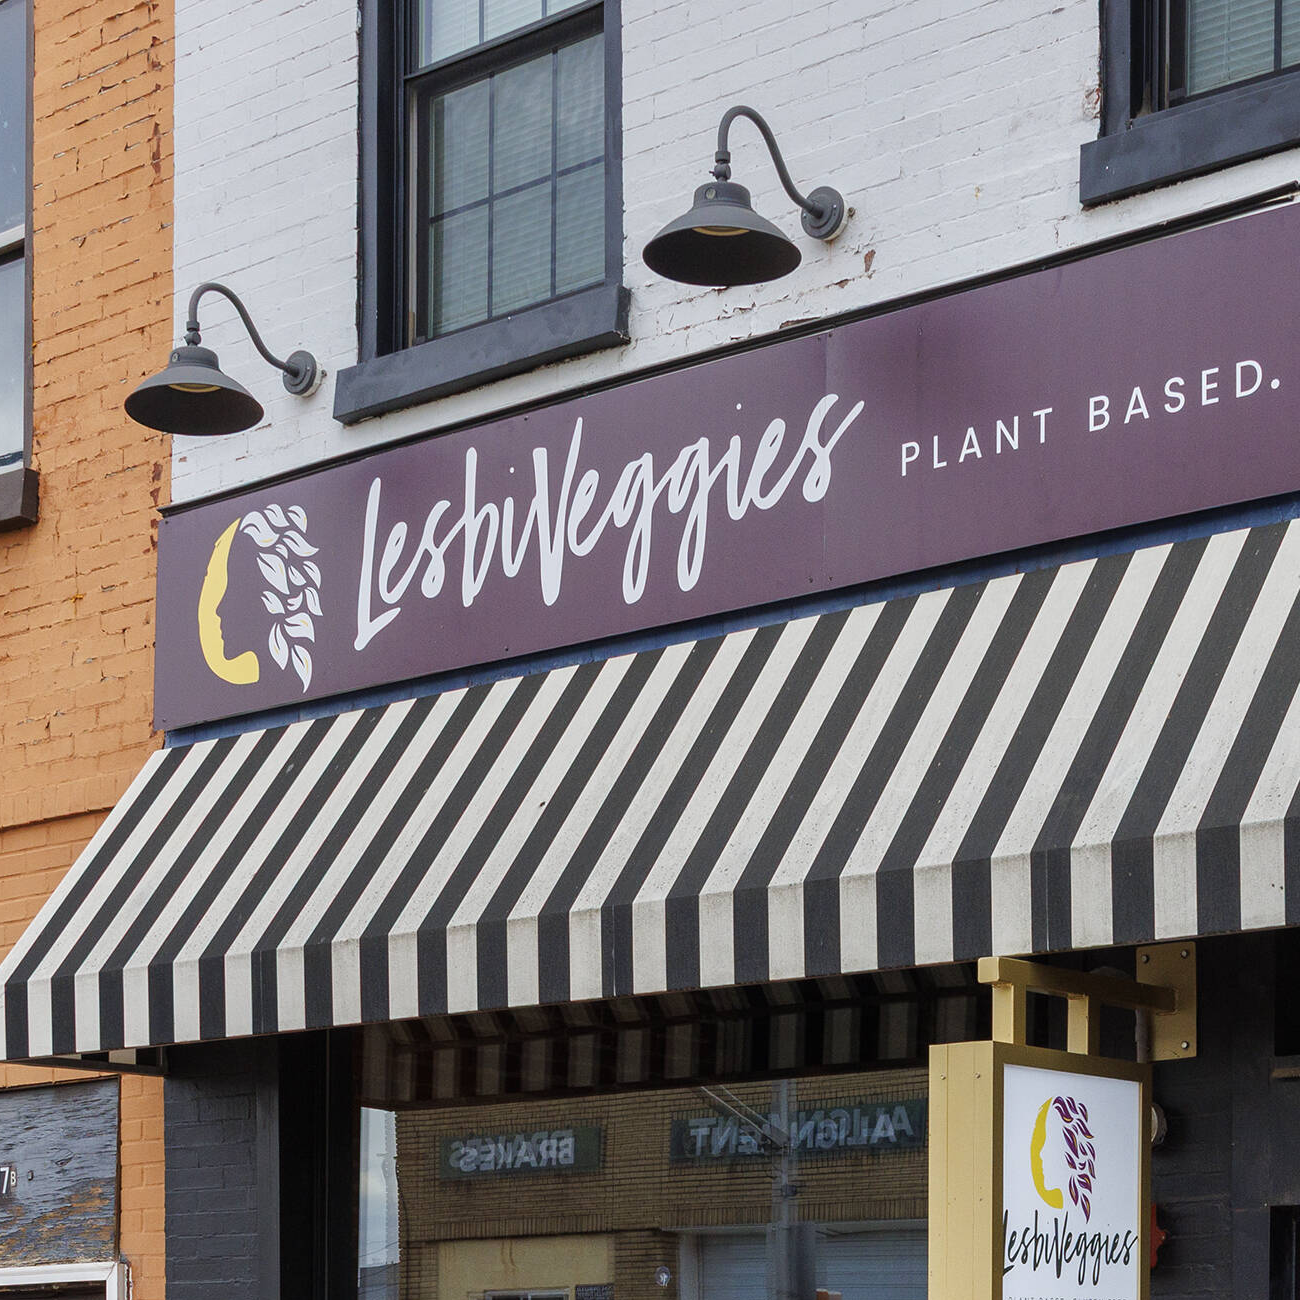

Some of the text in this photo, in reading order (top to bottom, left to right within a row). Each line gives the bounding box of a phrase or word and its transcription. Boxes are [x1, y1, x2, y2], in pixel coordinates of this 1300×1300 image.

[900, 406, 1054, 478] PLANT
[1088, 358, 1281, 433] BASED.
[354, 393, 864, 651] LesbiVeggies
